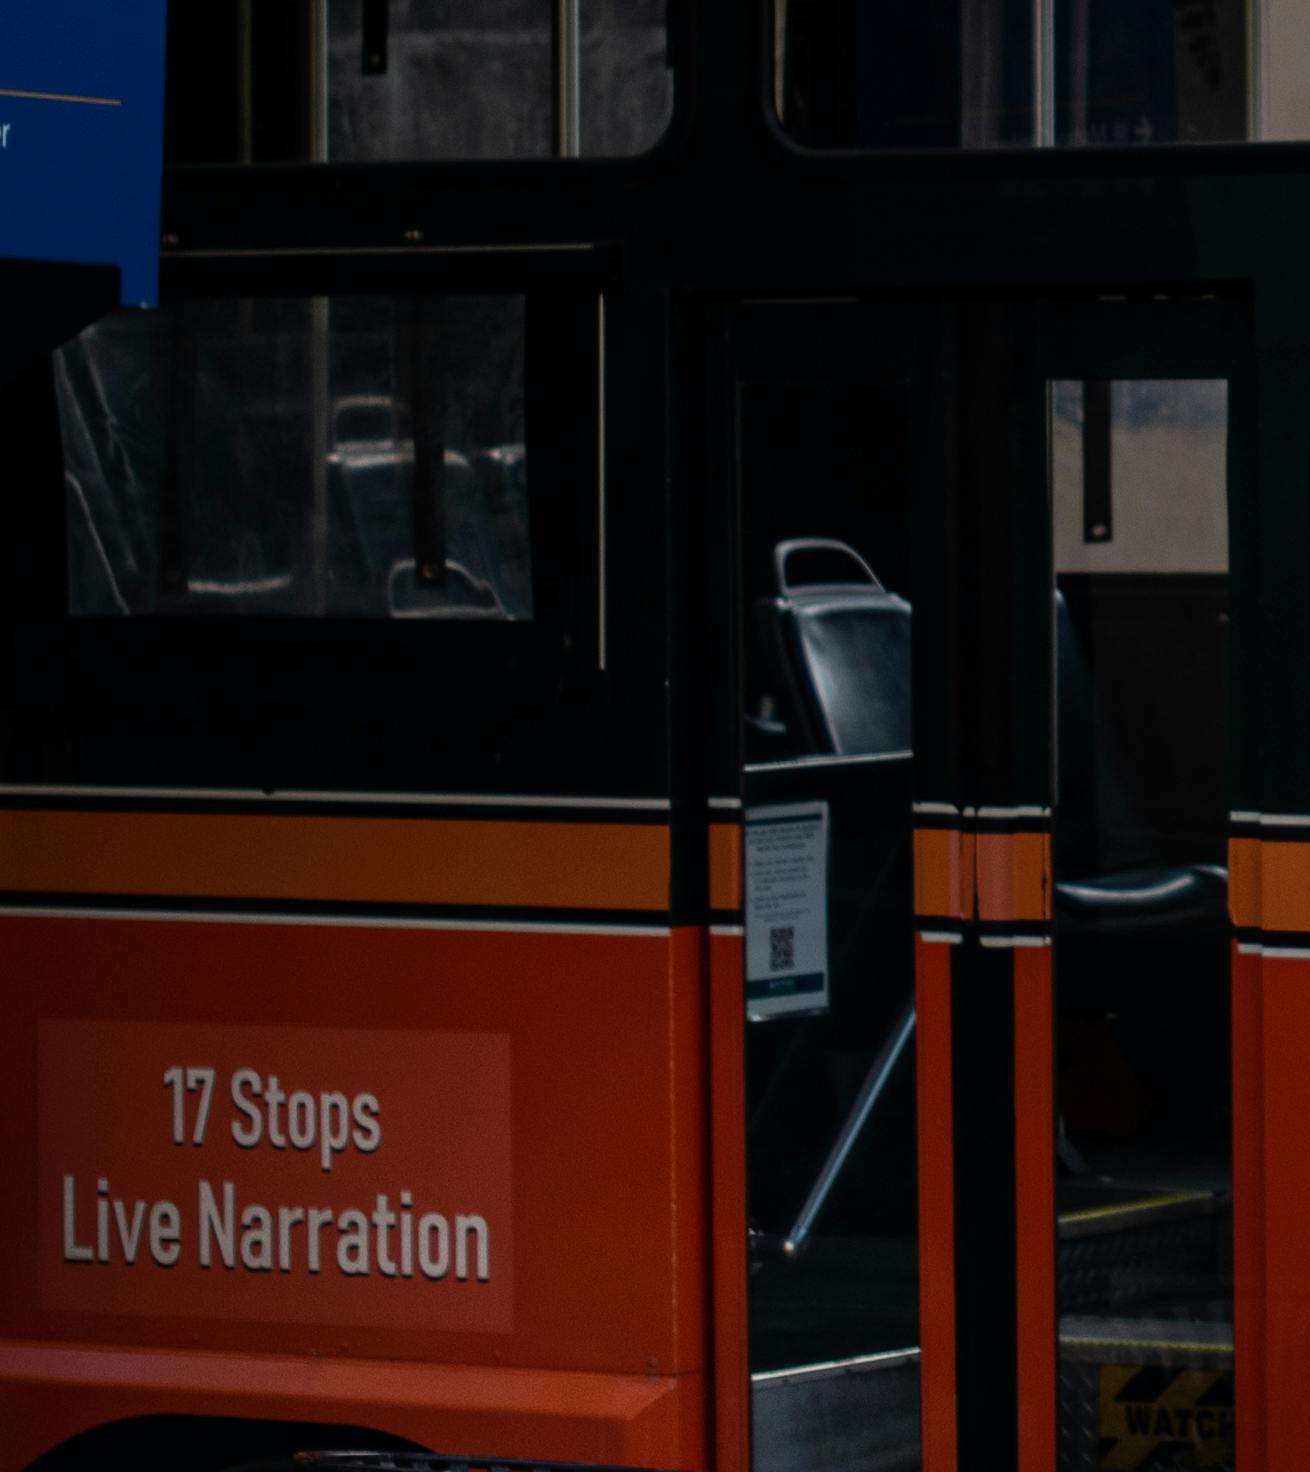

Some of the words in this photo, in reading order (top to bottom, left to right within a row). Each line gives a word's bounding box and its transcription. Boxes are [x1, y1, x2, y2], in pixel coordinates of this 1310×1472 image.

[162, 1064, 217, 1146] 17
[230, 1066, 382, 1172] Stops
[62, 1173, 182, 1266] Live
[199, 1180, 490, 1281] Narration
